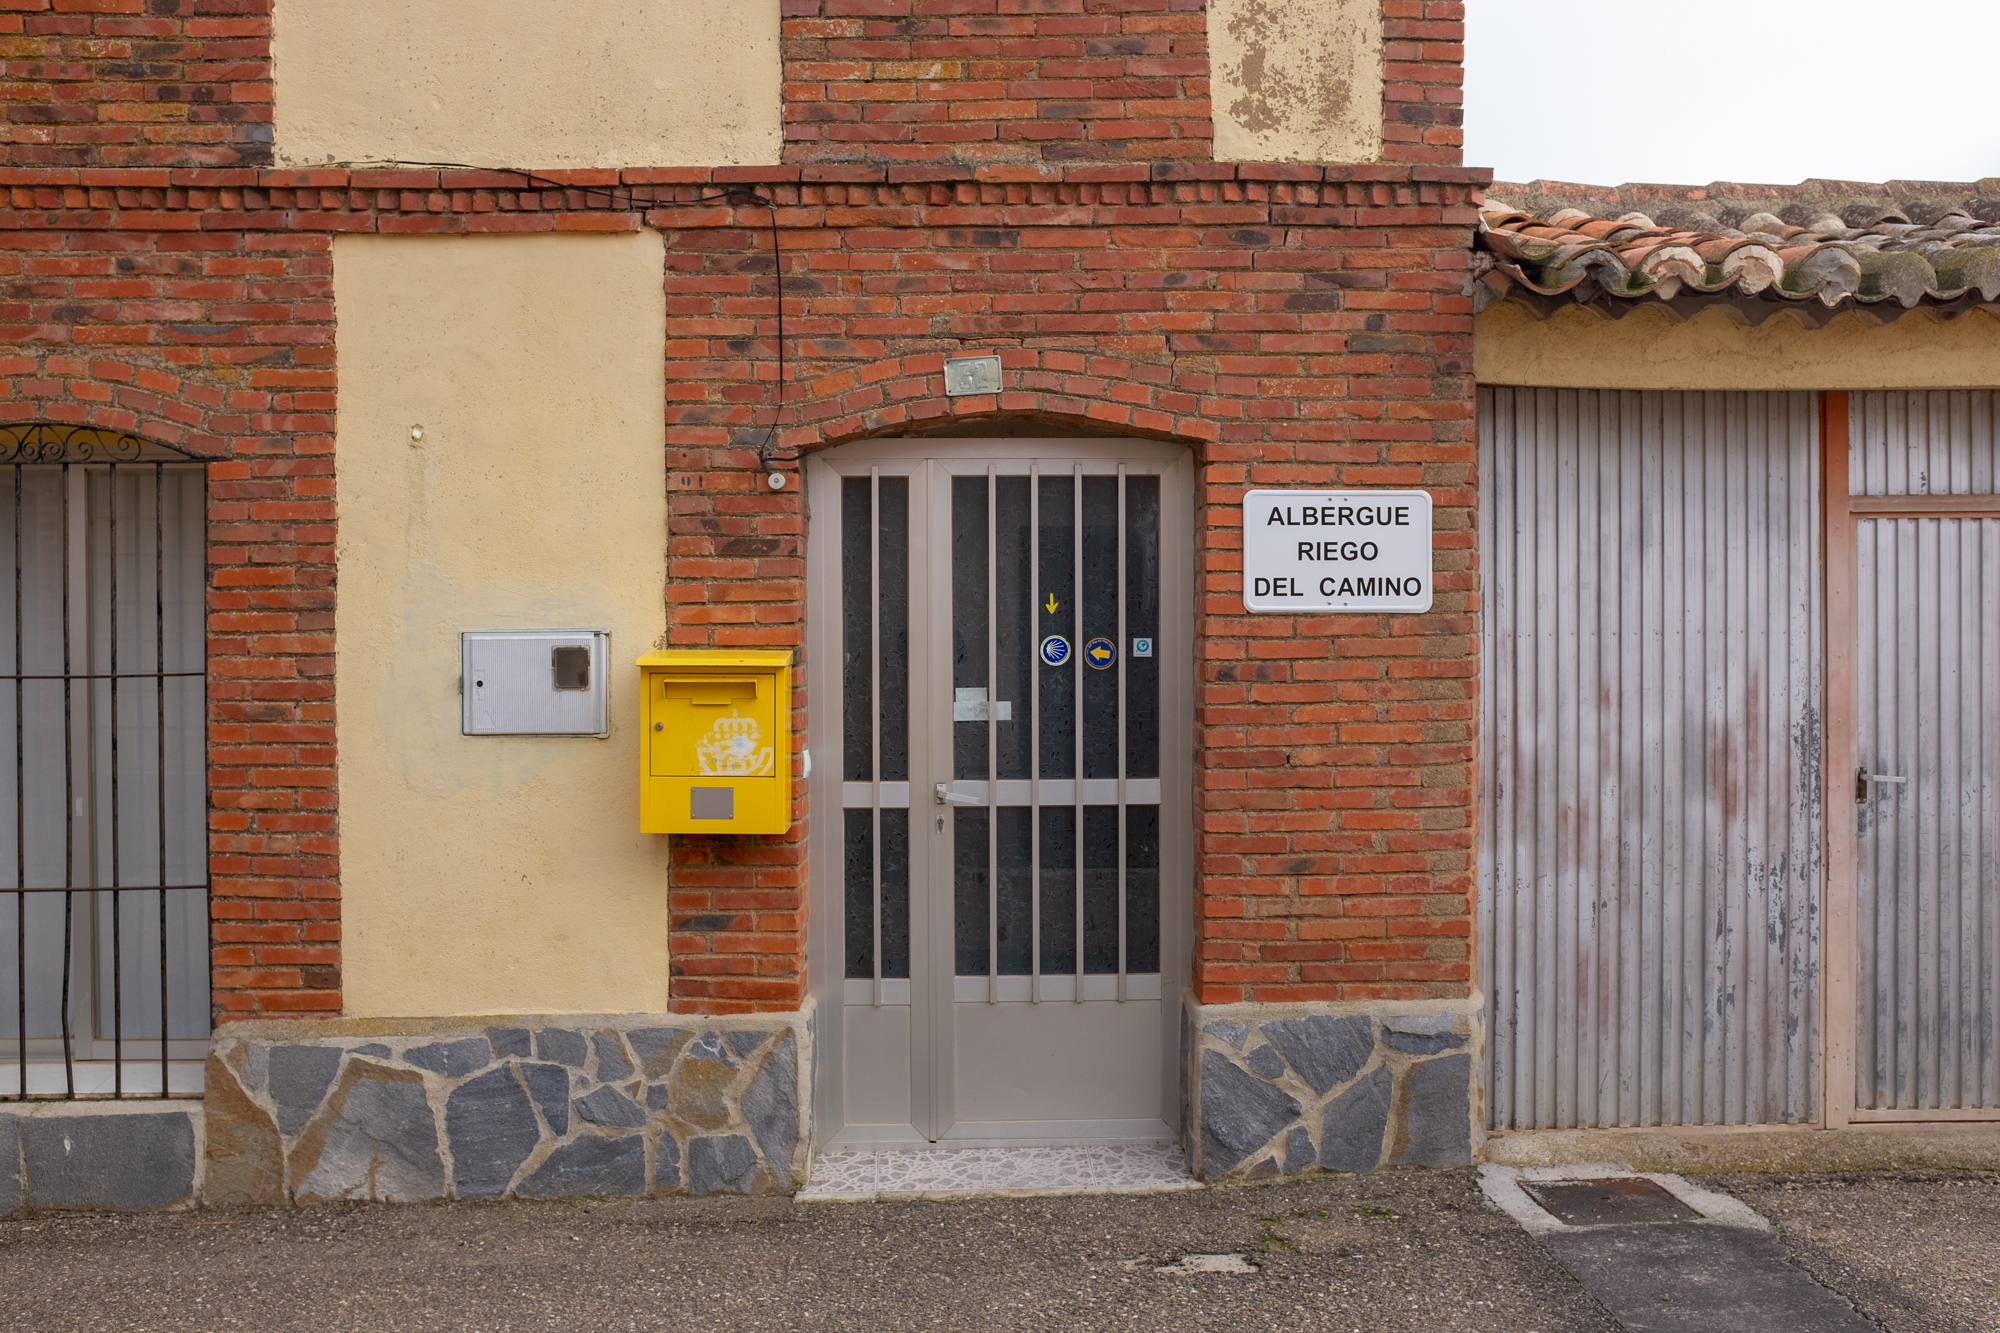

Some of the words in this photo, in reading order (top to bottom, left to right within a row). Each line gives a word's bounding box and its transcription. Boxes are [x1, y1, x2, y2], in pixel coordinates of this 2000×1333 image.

[957, 360, 988, 390] 32
[1267, 506, 1410, 526] ALBERGUE
[1297, 541, 1379, 561] RIEGO
[1254, 577, 1304, 597] DEL
[1319, 576, 1422, 597] CAMINO
